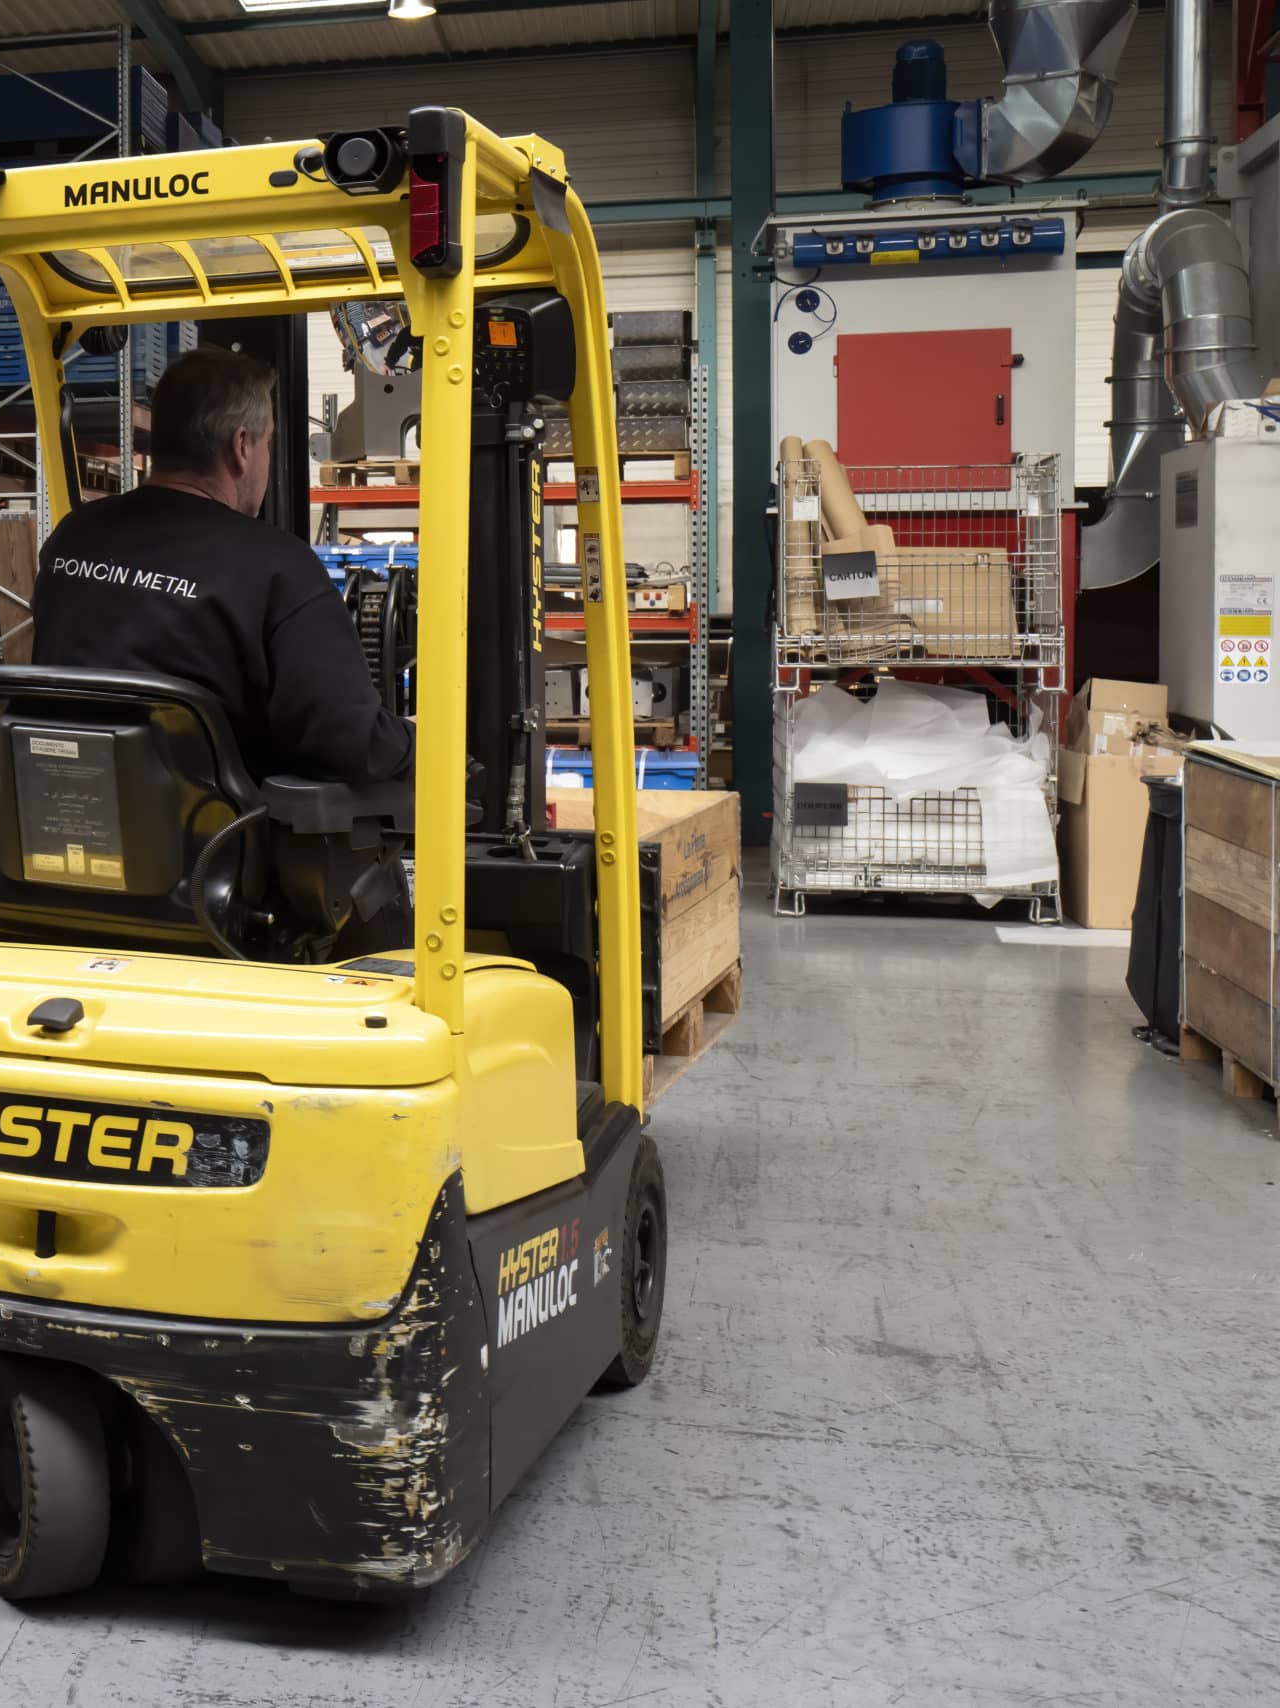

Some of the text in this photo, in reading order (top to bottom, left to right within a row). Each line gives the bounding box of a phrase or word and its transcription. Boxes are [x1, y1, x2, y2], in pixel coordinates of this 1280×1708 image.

[64, 172, 209, 207] MANULOC
[53, 557, 198, 598] PONCIN METAL
[531, 459, 542, 652] HYSTER
[497, 1227, 559, 1296] HYSTER
[497, 1258, 578, 1349] MANULOC
